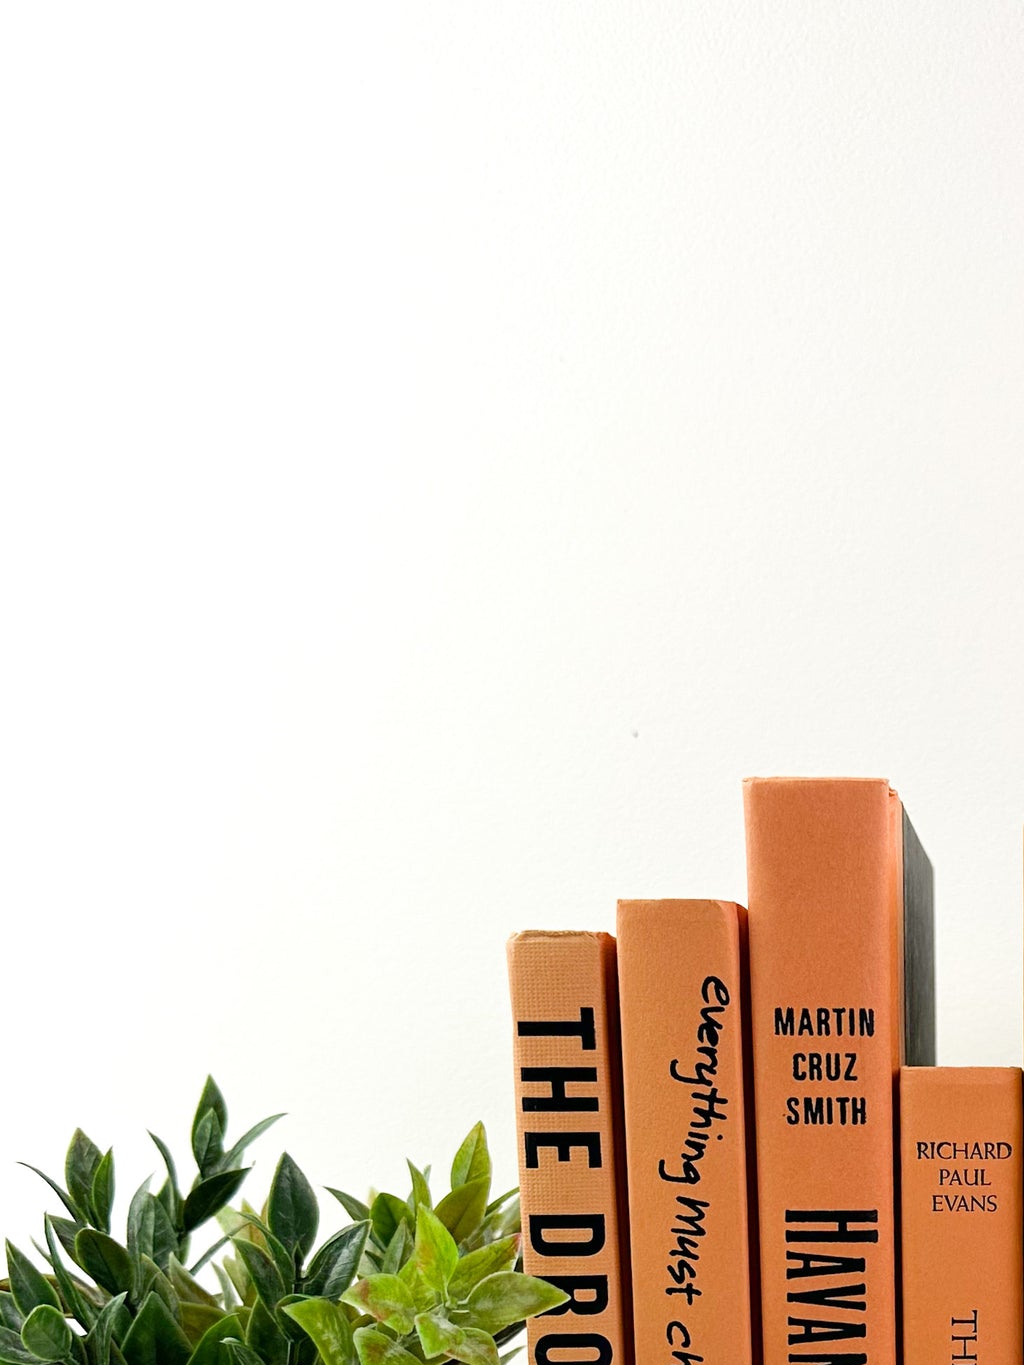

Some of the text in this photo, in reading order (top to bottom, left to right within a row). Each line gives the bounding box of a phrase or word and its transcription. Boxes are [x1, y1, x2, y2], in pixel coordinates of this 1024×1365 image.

[774, 1006, 875, 1038] MARTIN
[658, 975, 731, 1185] everything
[792, 1052, 858, 1082] CRUZ
[517, 1006, 603, 1169] THE
[786, 1096, 867, 1126] SMITH
[916, 1141, 1013, 1160] RICHARD
[939, 1168, 992, 1186] PAUL
[932, 1194, 998, 1213] EVANS
